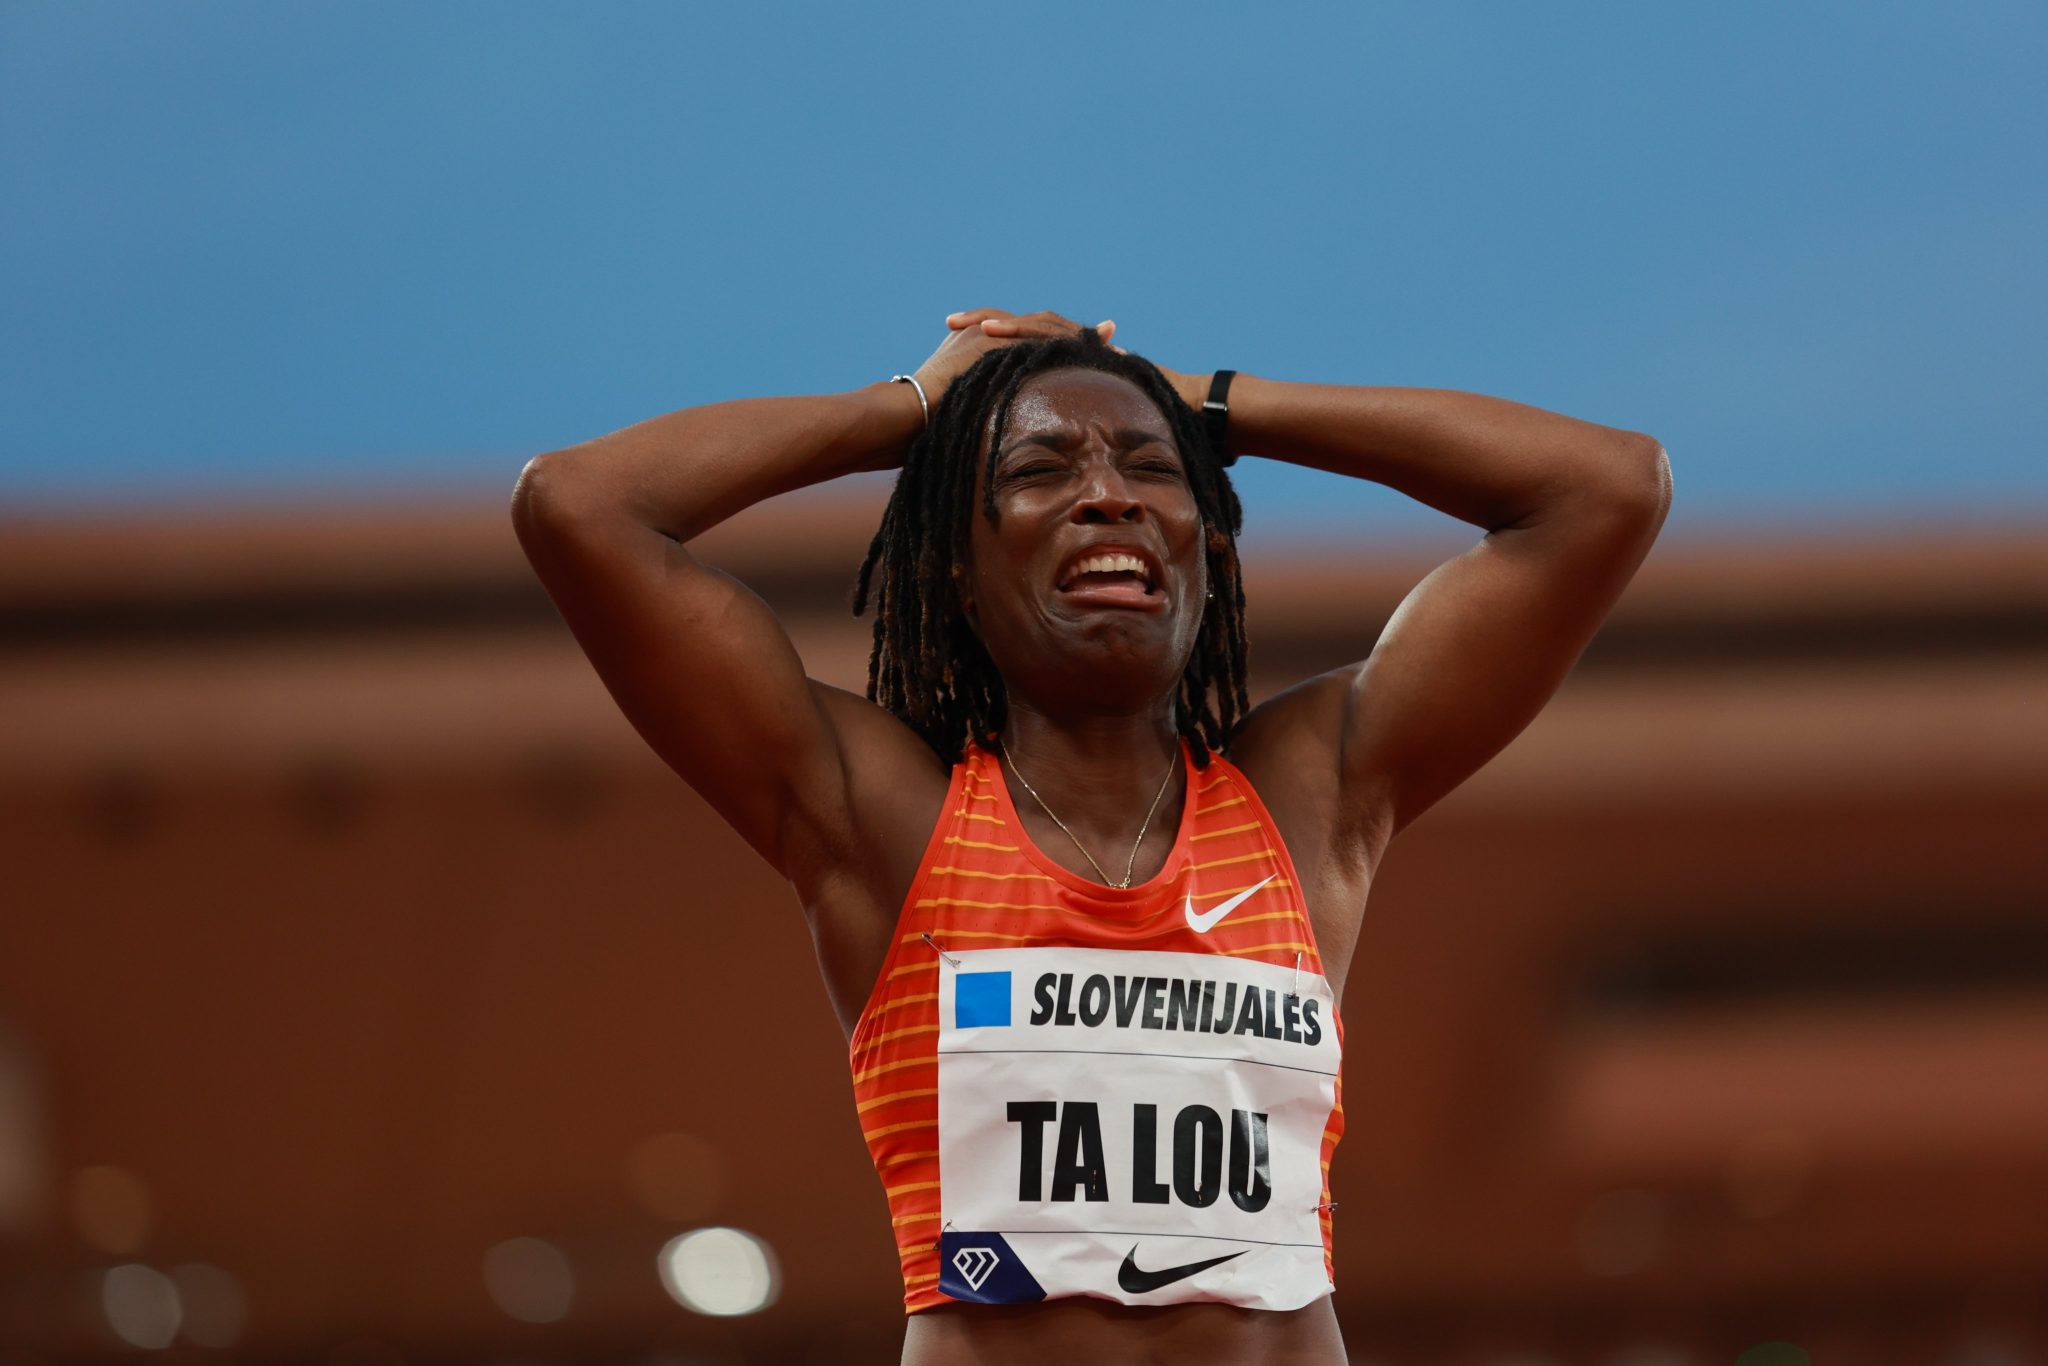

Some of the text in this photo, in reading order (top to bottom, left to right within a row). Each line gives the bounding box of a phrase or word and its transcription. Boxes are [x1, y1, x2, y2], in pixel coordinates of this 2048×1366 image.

[1030, 972, 1322, 1046] SLOVENIJALES
[1006, 1101, 1272, 1213] TA LOU
